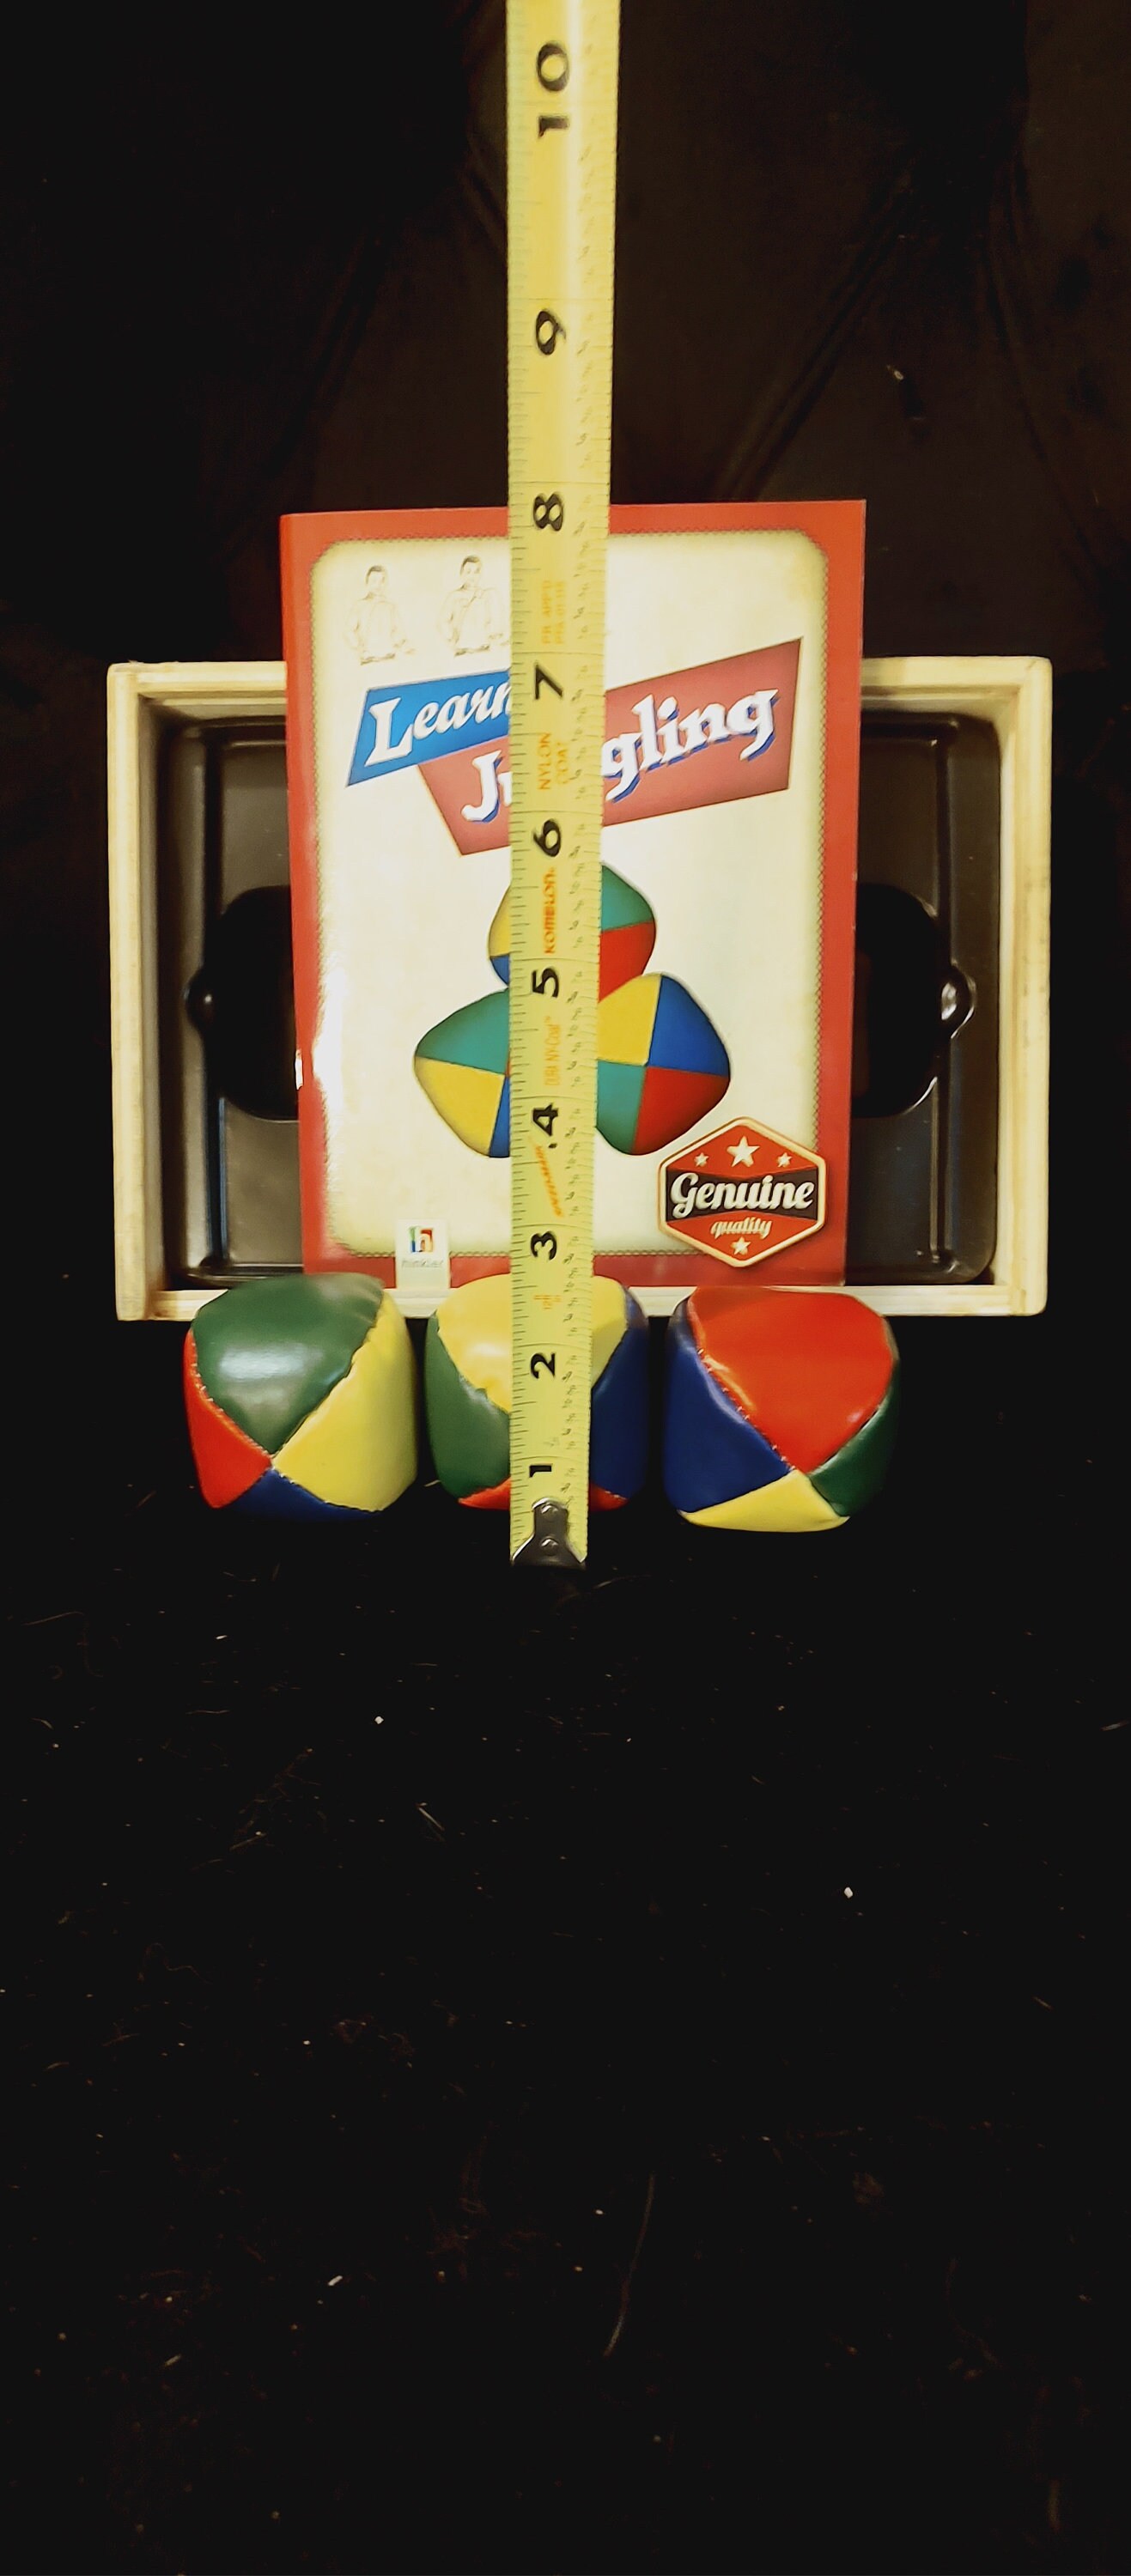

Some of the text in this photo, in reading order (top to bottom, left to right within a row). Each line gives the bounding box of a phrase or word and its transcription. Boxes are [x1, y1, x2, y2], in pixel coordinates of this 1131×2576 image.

[535, 40, 570, 140] 10
[535, 310, 567, 355] 9
[532, 493, 564, 532] 8
[534, 661, 563, 701] 7
[364, 682, 514, 767] Learn
[460, 688, 781, 823] Jgling
[538, 732, 552, 791] NYLON
[532, 818, 562, 858] 6
[531, 966, 559, 999] 5
[532, 1103, 559, 1137] 4
[670, 1172, 815, 1219] Genuine
[530, 1230, 557, 1261] 3
[710, 1217, 772, 1240] quality
[530, 1352, 556, 1379] 2
[529, 1463, 553, 1478] 1
